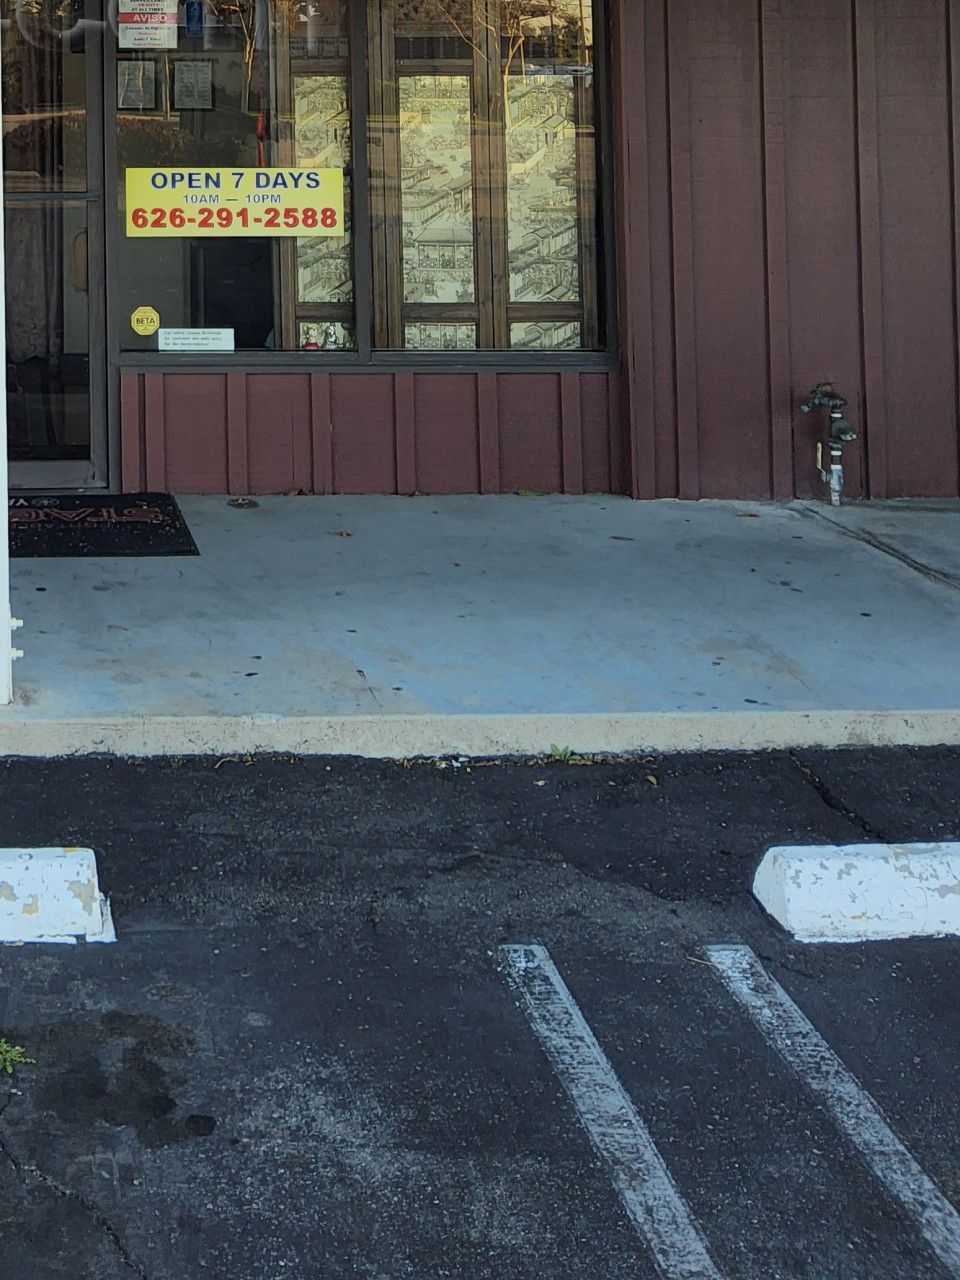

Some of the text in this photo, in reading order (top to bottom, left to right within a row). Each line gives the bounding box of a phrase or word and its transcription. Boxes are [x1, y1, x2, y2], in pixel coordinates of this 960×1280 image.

[133, 14, 168, 22] AVISO
[151, 172, 321, 189] OPEN 7 DAYS
[183, 194, 220, 204] 10AM
[245, 194, 282, 204] 10PM
[131, 207, 338, 229] 626-291-2588
